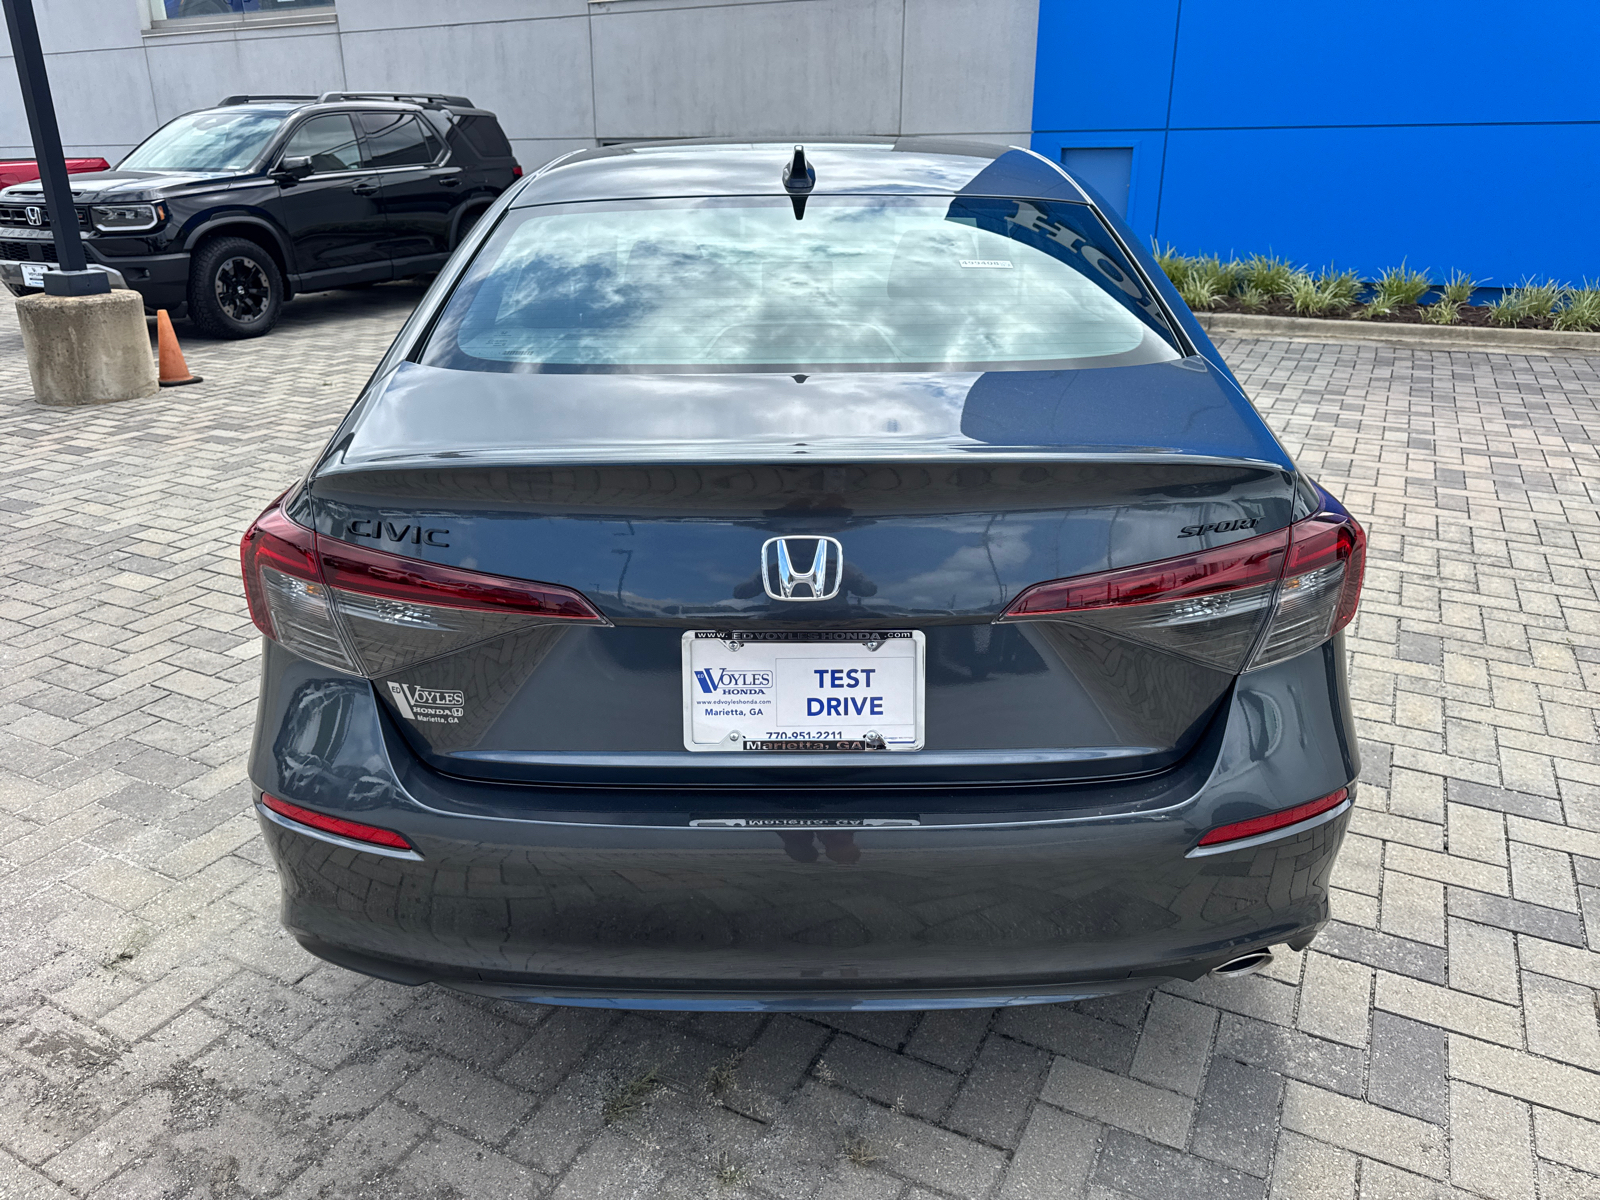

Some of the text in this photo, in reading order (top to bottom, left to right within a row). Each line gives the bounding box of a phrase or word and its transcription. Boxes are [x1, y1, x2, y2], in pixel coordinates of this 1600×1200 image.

[347, 519, 450, 548] CIVIC
[1177, 517, 1266, 538] SPORT
[703, 668, 770, 691] VOYLES
[814, 668, 876, 688] TEST
[391, 683, 463, 706] ED VOYLES
[413, 706, 452, 715] HONDA
[705, 708, 764, 717] Marietta, GA
[807, 696, 884, 716] DRIVE
[417, 715, 447, 724] Marietta,
[766, 731, 843, 739] 770-951-2211
[746, 741, 863, 750] Marietta, GA
